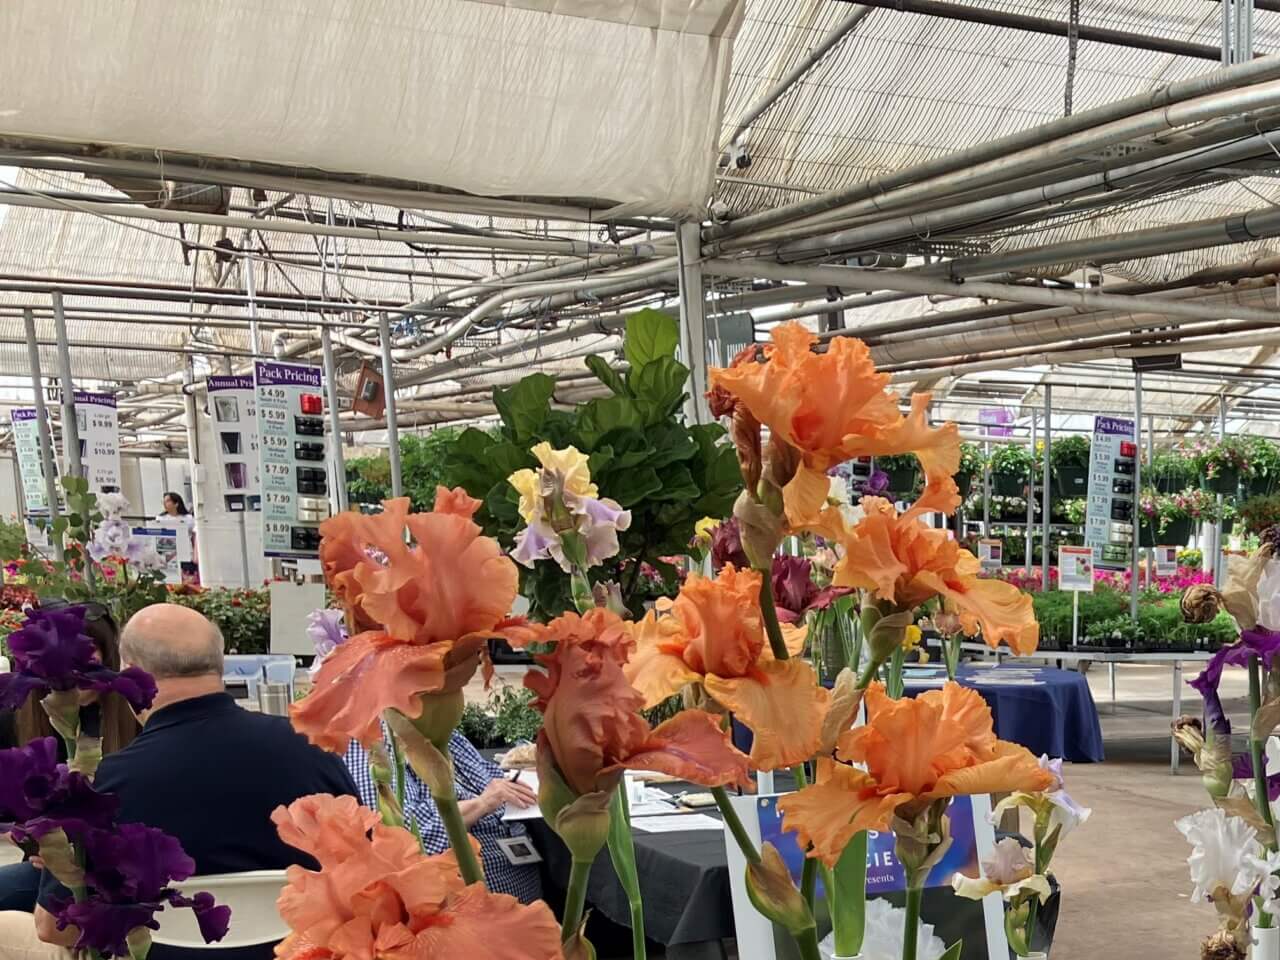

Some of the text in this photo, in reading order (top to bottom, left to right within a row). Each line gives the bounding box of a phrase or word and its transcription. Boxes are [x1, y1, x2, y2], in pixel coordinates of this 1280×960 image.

[259, 366, 319, 385] Pack Pricing
[208, 378, 238, 387] Annual
[866, 874, 895, 884] resents
